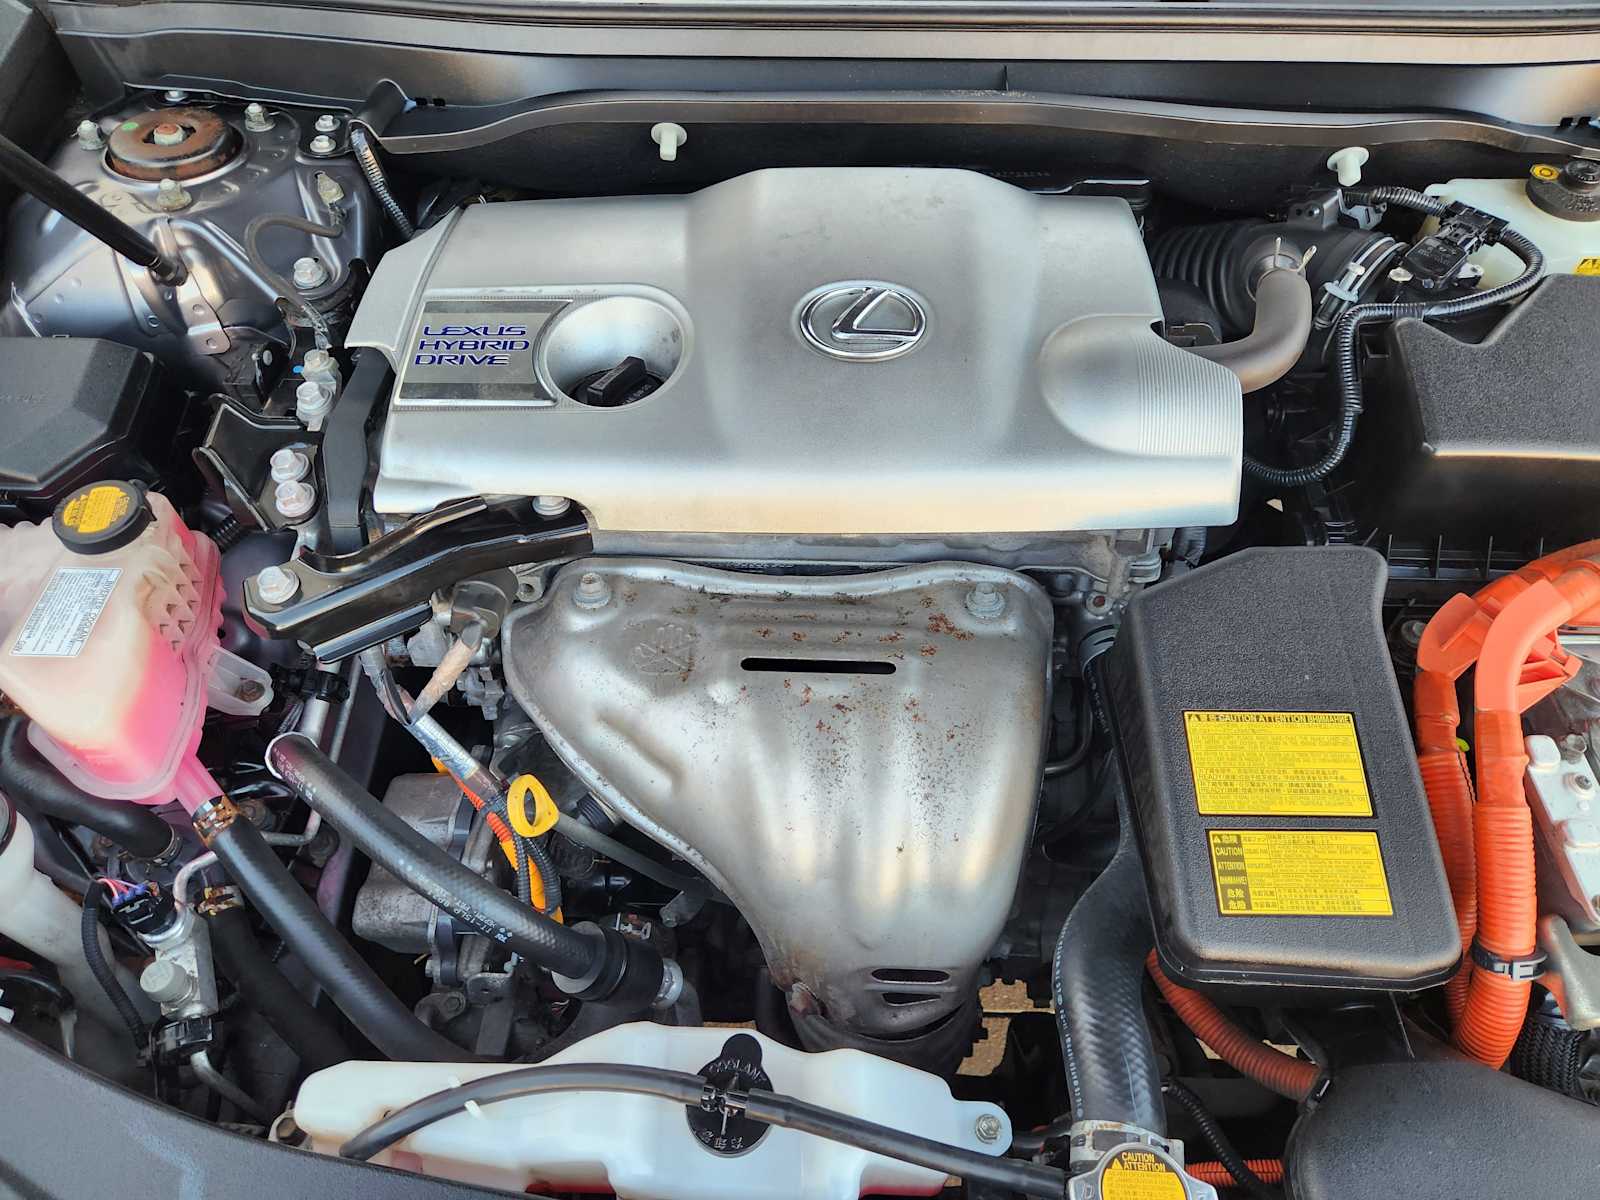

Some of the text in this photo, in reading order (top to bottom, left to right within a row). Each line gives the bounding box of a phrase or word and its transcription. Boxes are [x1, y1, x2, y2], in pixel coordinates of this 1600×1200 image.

[423, 325, 527, 336] LEXUS
[419, 340, 531, 351] HYBRID
[414, 354, 510, 365] DRIVE
[1219, 713, 1257, 722] CAUTION
[1259, 714, 1307, 723] ATTENTION
[1215, 847, 1243, 857] CAUTION
[1121, 1152, 1155, 1162] CAUTION
[1123, 1162, 1166, 1172] ATTENTION
